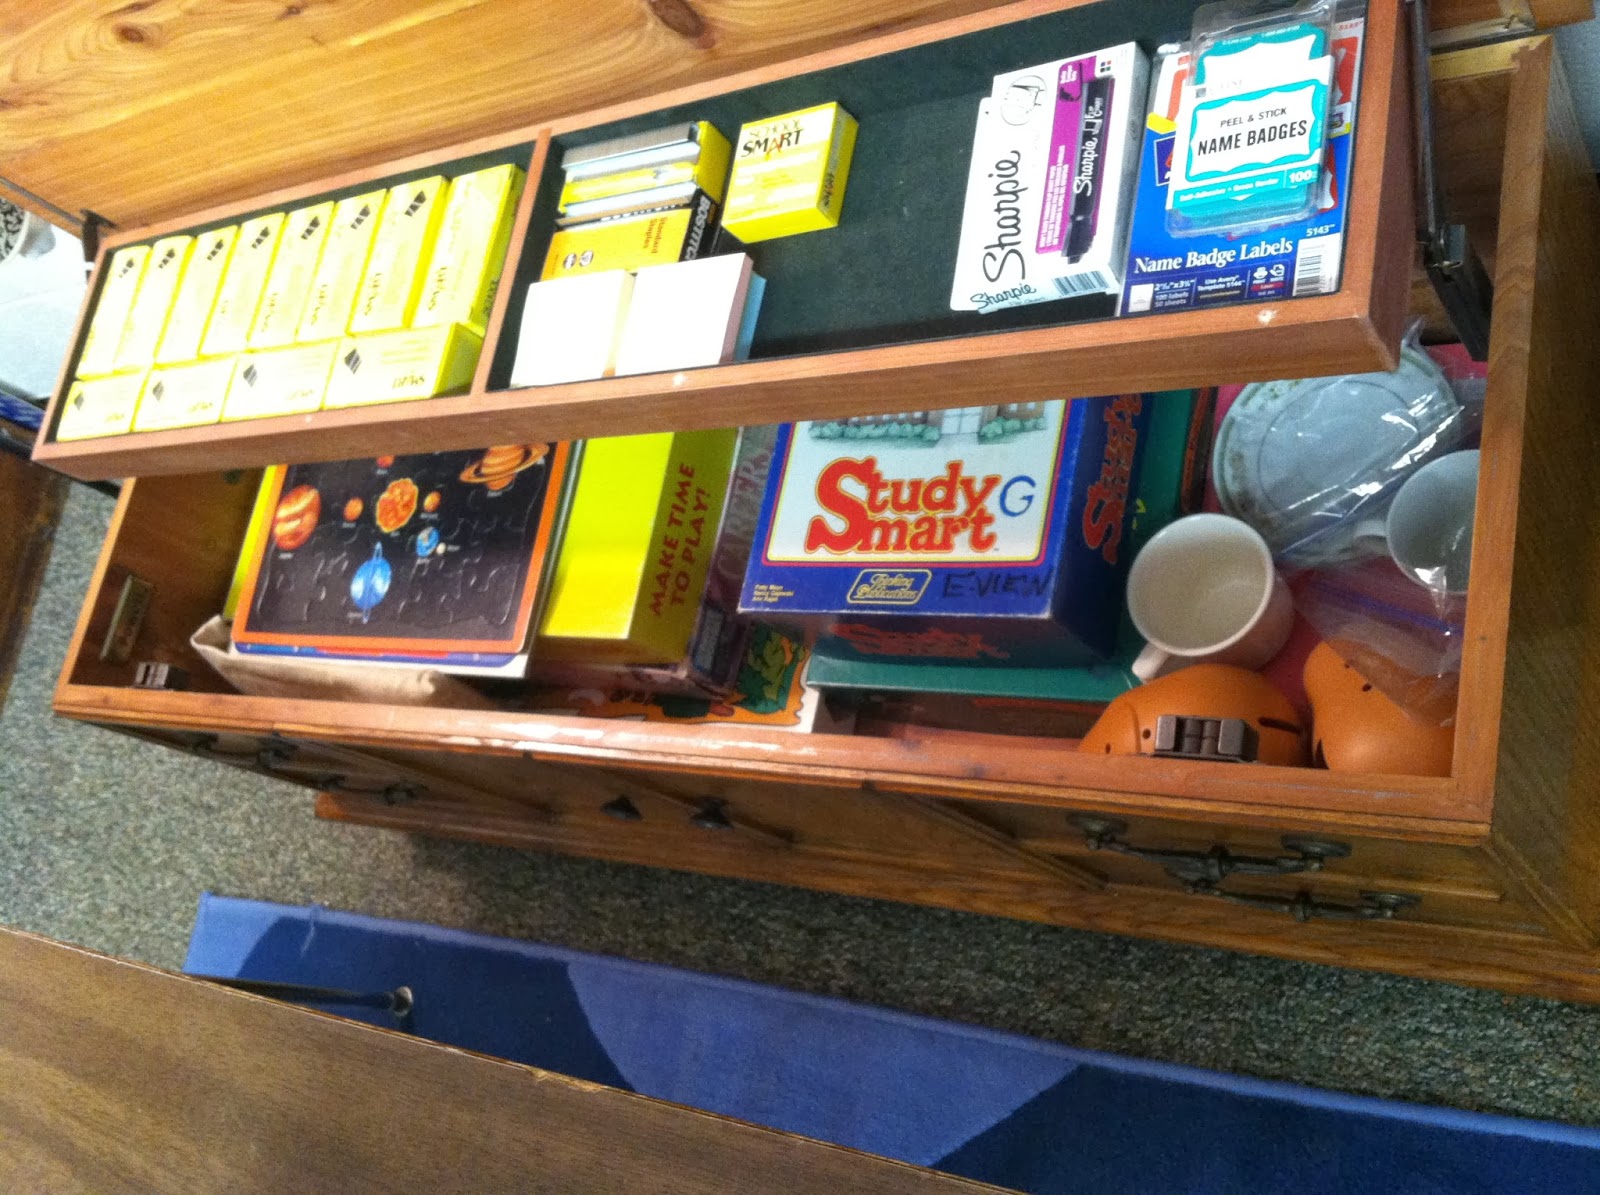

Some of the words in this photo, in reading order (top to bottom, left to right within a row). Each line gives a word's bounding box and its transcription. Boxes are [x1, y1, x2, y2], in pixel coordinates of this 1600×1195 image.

[1198, 132, 1242, 157] NAME
[1246, 118, 1308, 148] BADGES
[1220, 114, 1244, 128] PEEL
[1247, 112, 1255, 123] &
[1259, 106, 1288, 121] STICK
[740, 128, 804, 158] SMART
[1073, 137, 1099, 197] Sharpie
[1288, 169, 1313, 185] 100
[684, 194, 712, 261] BOSTITC
[982, 150, 1029, 283] Sharpie
[1133, 256, 1183, 275] Name
[1185, 248, 1237, 269] Badge
[1239, 237, 1294, 261] Labels
[970, 283, 1037, 310] Sharpie
[808, 455, 1002, 530] Study
[999, 475, 1037, 517] G
[651, 535, 679, 616] MAKE
[667, 462, 695, 528] TIME
[670, 570, 691, 606] TO
[681, 486, 711, 565] PLAY!
